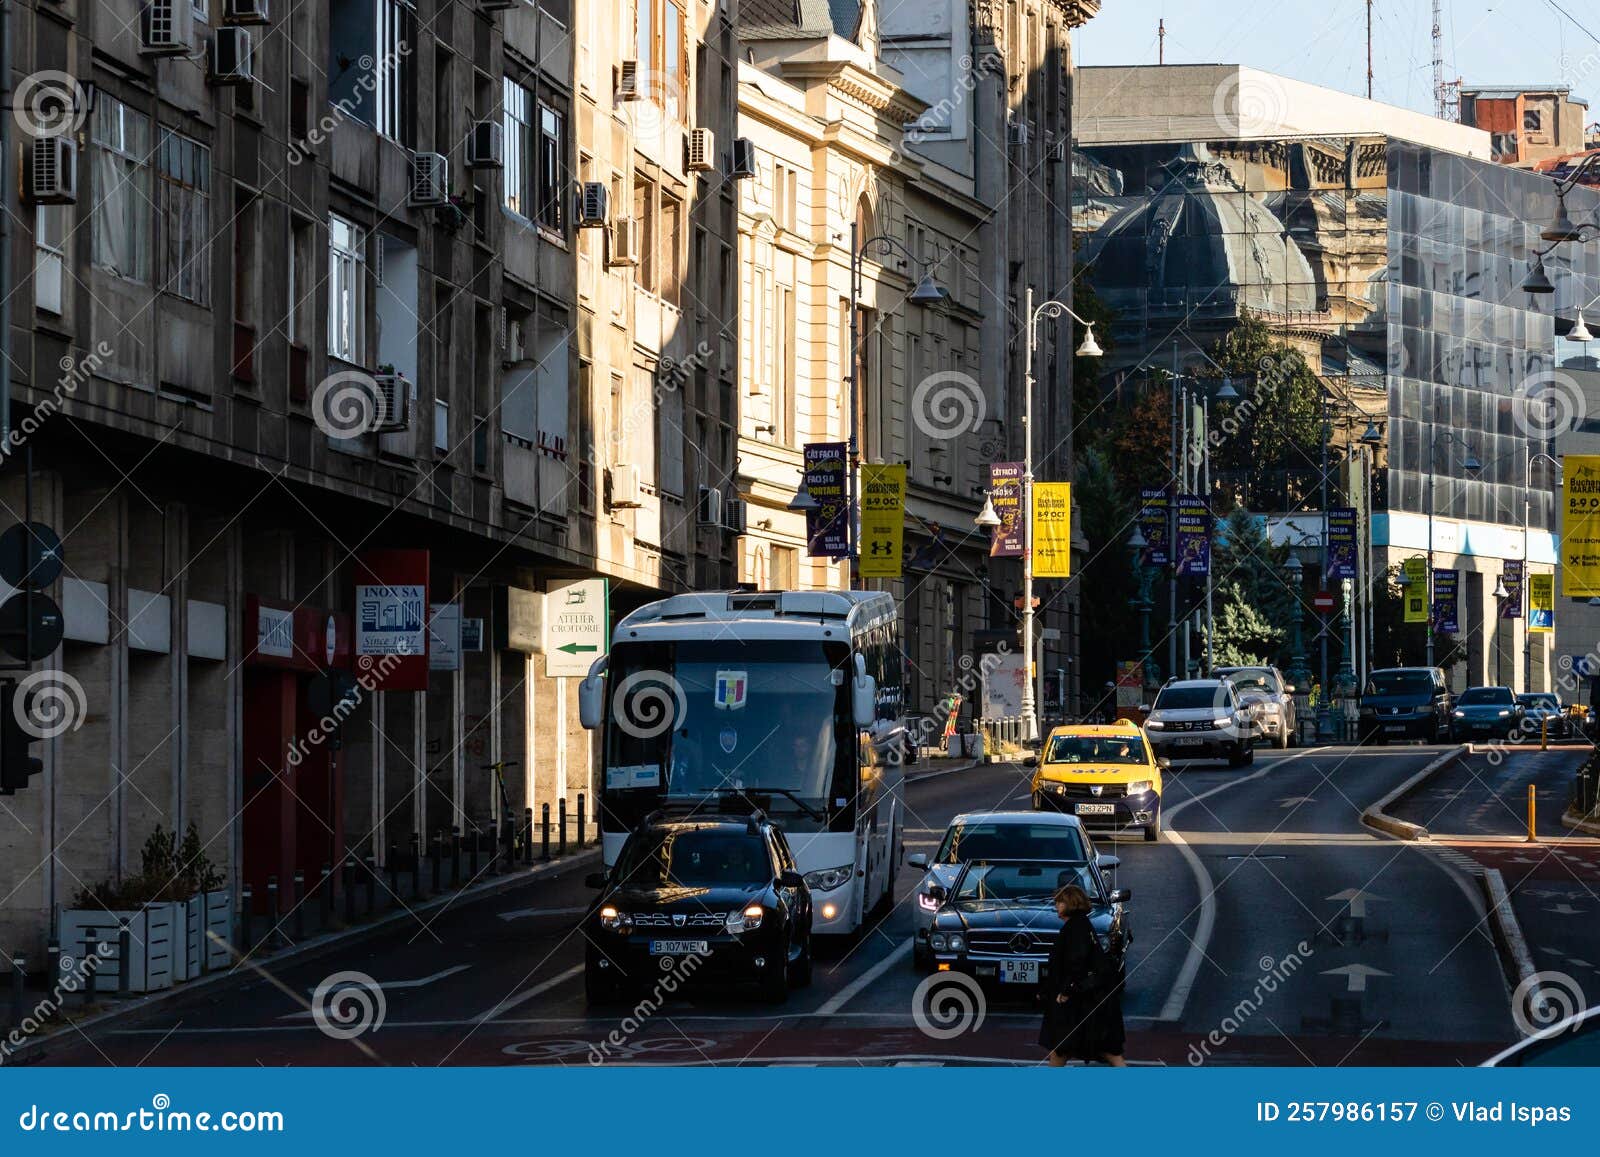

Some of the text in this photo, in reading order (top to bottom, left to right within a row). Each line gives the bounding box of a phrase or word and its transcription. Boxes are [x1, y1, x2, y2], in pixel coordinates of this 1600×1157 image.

[1570, 498, 1587, 507] 8-9
[364, 587, 418, 597] INOX SA
[558, 614, 594, 624] ATELIER
[551, 624, 600, 633] CROITORIE
[363, 635, 389, 645] Since
[655, 941, 662, 952] B
[665, 941, 681, 952] 107
[1007, 961, 1035, 971] B 103
[1012, 971, 1027, 981] AIR
